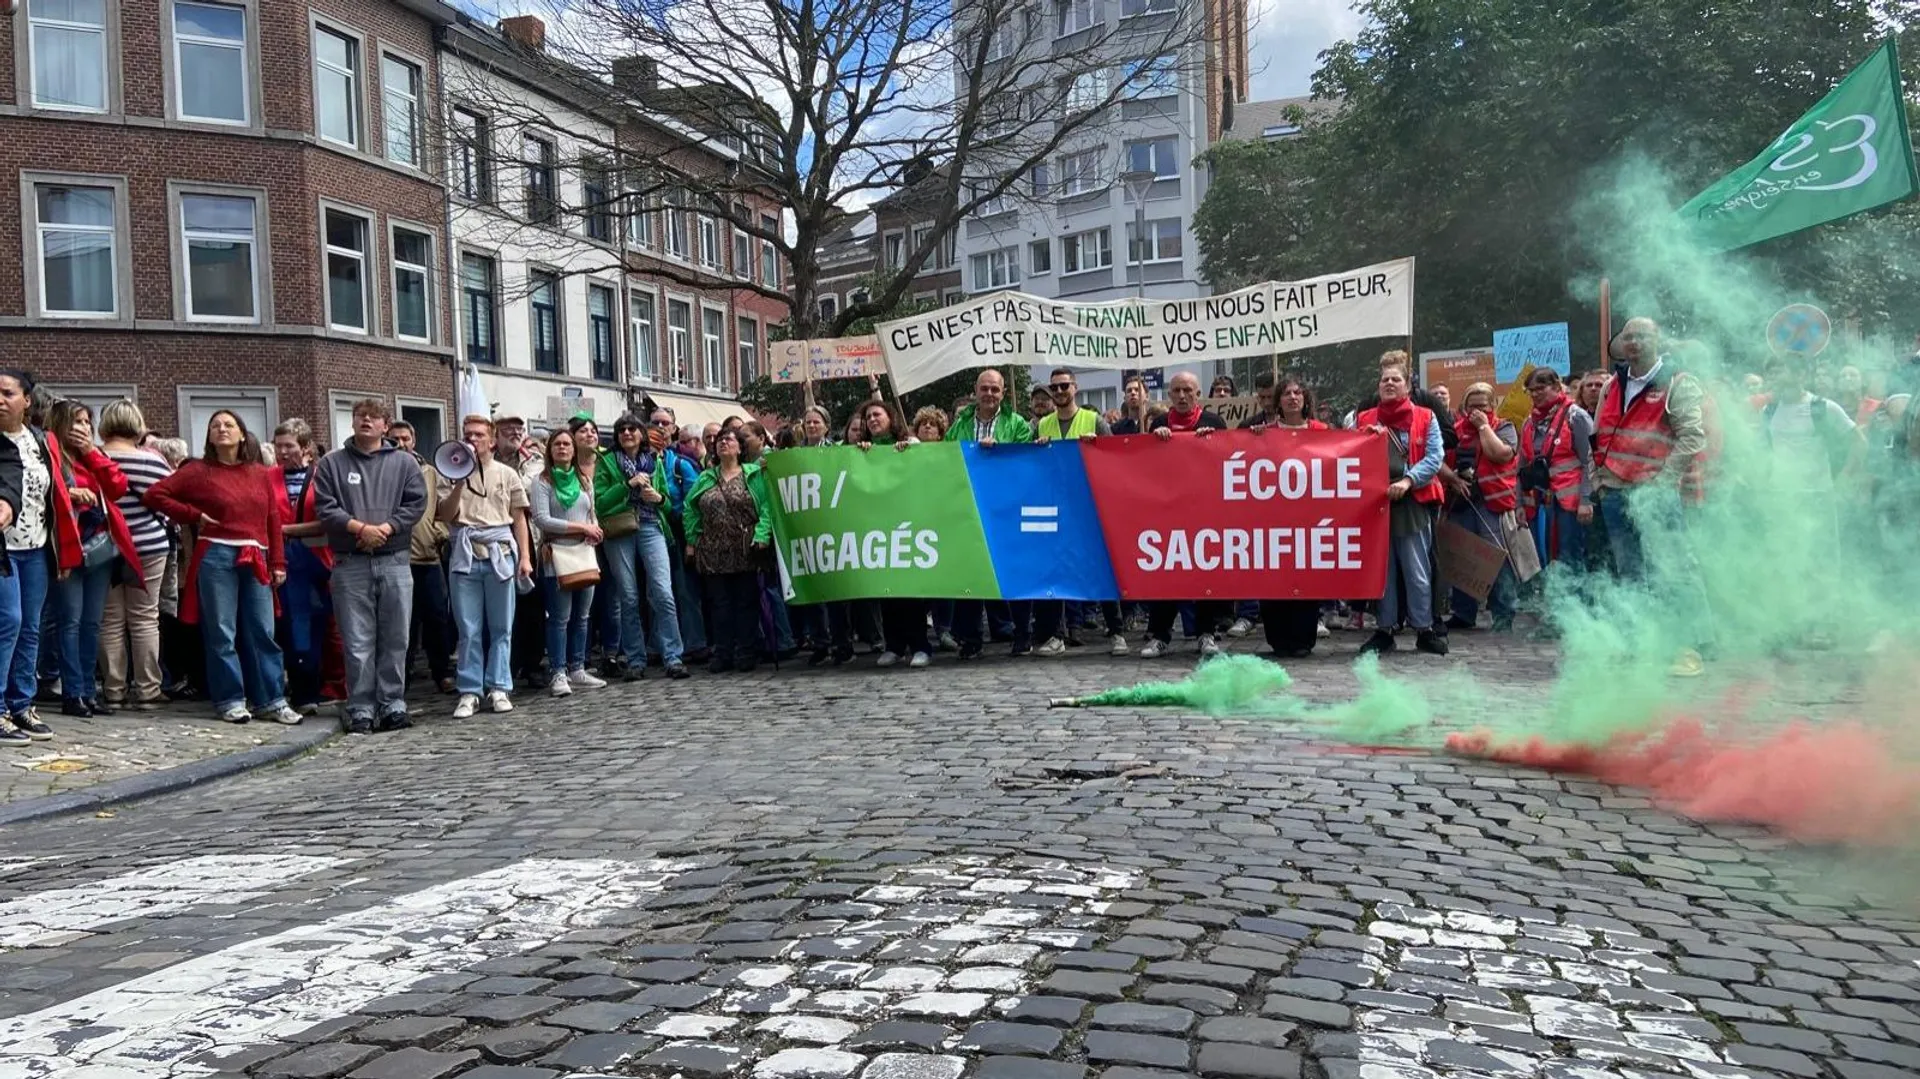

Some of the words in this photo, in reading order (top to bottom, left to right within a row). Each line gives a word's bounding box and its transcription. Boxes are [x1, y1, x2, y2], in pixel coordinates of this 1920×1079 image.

[891, 325, 922, 351] CE
[927, 306, 984, 342] N'EST
[993, 299, 1032, 322] PAS
[1039, 305, 1066, 325] LE
[1073, 305, 1154, 328] TRAVAIL
[1162, 301, 1197, 324] QUI
[1205, 291, 1264, 320] NOUS
[1274, 283, 1317, 311] FAIT
[1327, 273, 1392, 303] PEUR,
[971, 331, 1025, 355] C'EST
[1034, 332, 1118, 358] L'AVENIR
[1125, 335, 1153, 359] DE
[1162, 330, 1207, 354] VOS
[1215, 314, 1319, 350] ENFANTS!
[777, 472, 822, 514] MR
[830, 470, 847, 508] /
[1222, 451, 1361, 500] ÉCOLE
[790, 521, 939, 577] ENGAGÉS
[1136, 518, 1362, 571] SACRIFIÉE
